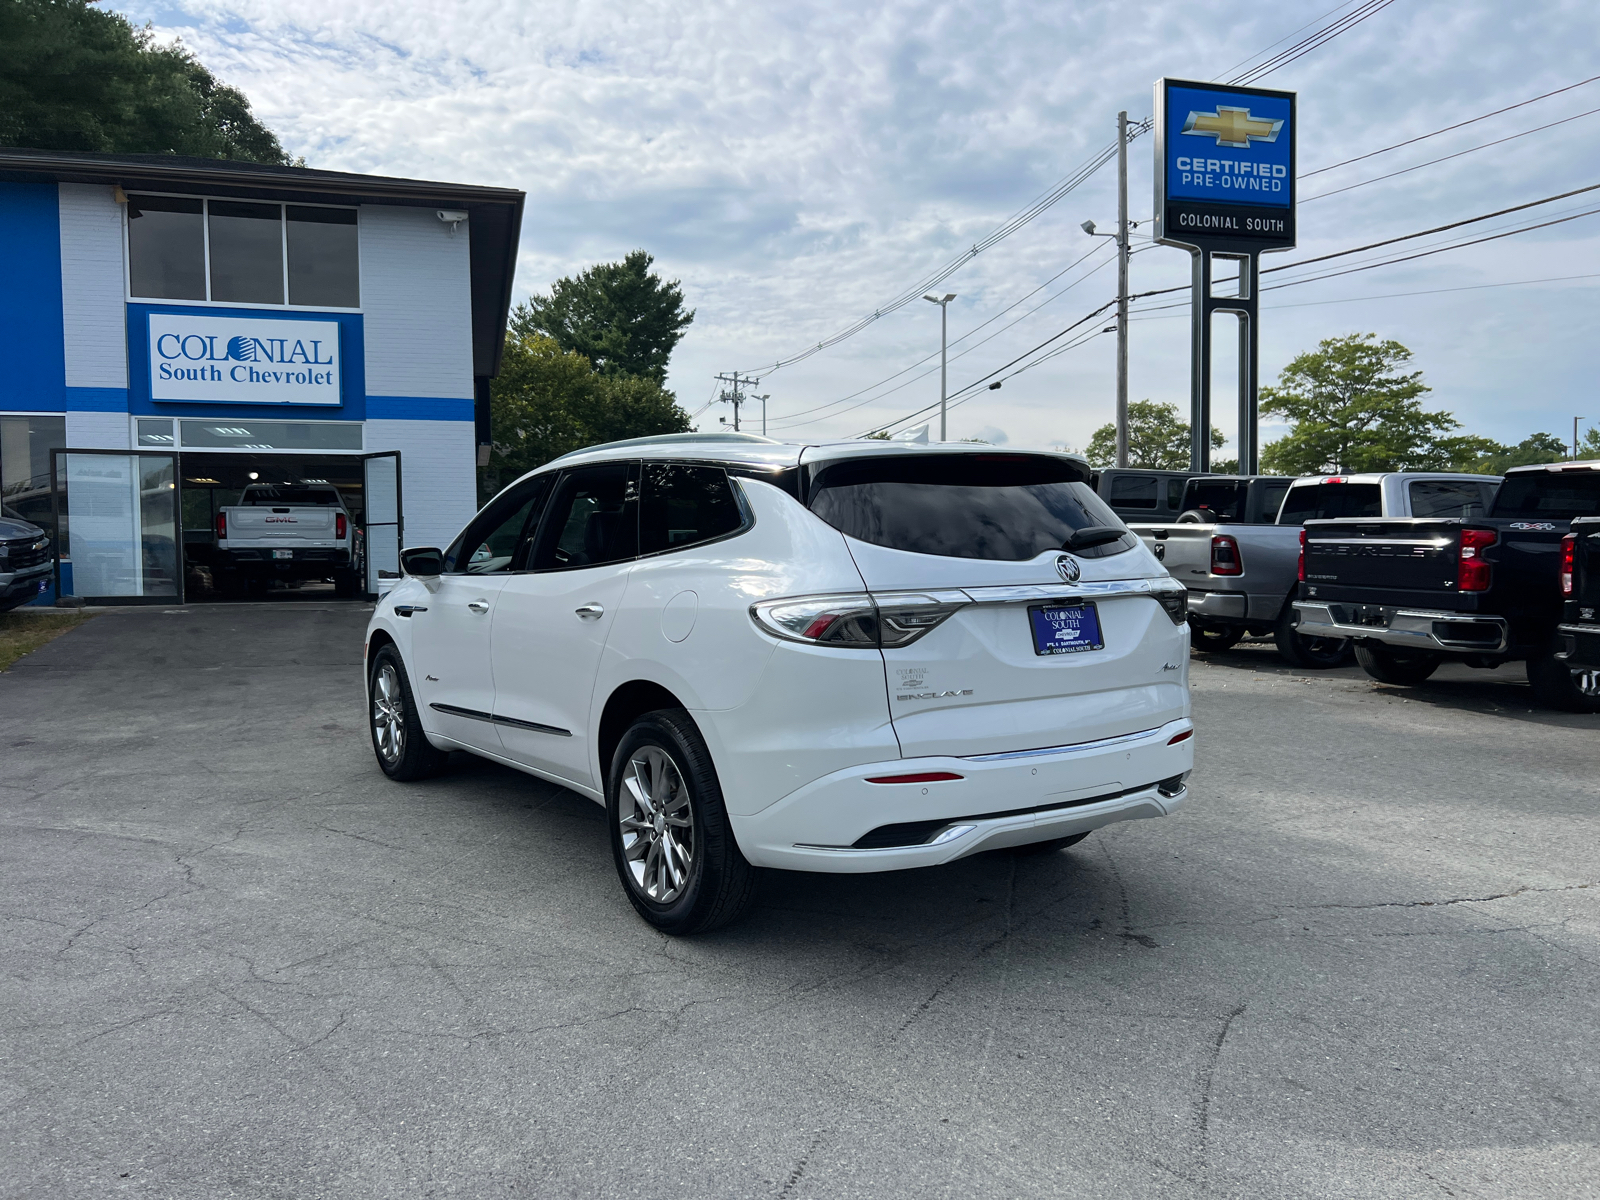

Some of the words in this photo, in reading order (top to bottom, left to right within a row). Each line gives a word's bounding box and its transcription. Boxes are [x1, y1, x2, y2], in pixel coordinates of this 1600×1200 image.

[1177, 157, 1286, 178] CERTIFIED
[1182, 173, 1281, 191] PRE-OWNED
[1180, 213, 1239, 229] COLONIAL
[1246, 218, 1284, 232] SOUTH
[157, 333, 333, 365] COLONIAL
[159, 362, 222, 382] South
[230, 365, 333, 385] Chevrolet
[1044, 610, 1085, 621] COLONIAL
[1052, 620, 1080, 629] SOUTH
[896, 689, 974, 701] ENCLAVE
